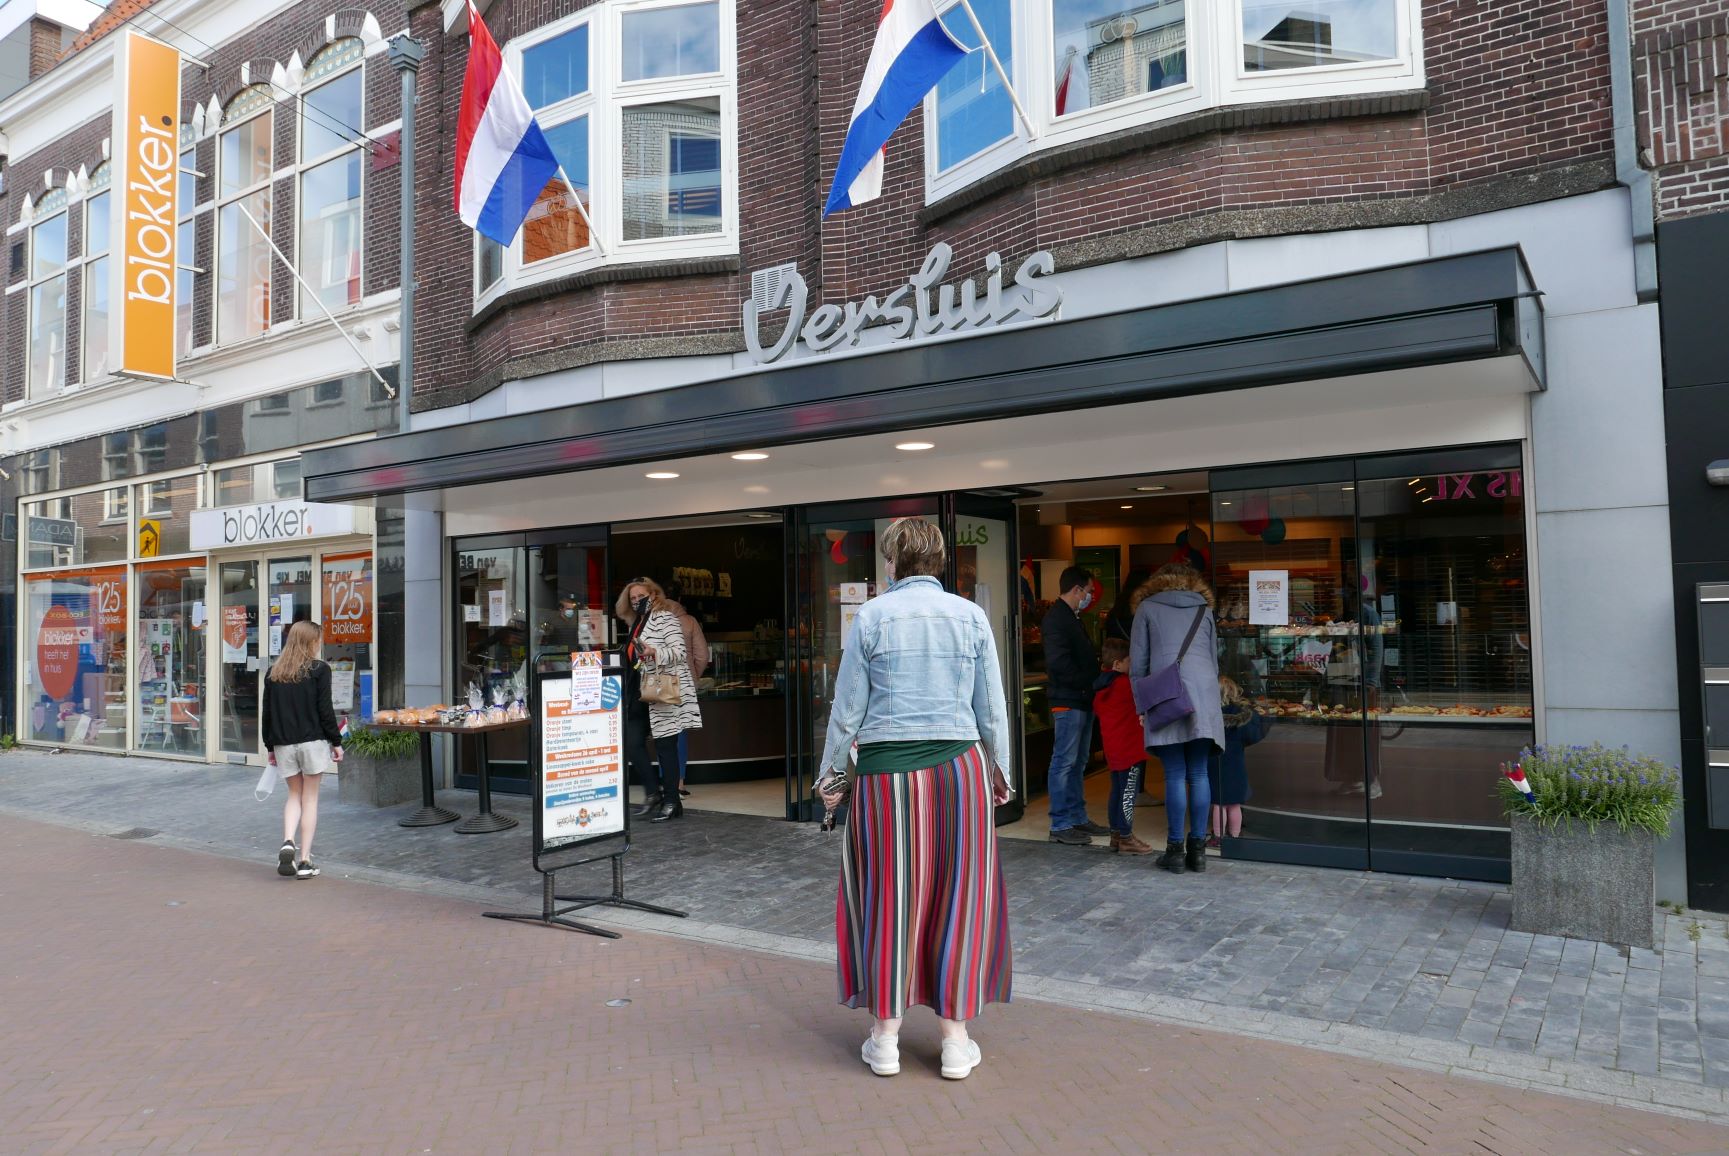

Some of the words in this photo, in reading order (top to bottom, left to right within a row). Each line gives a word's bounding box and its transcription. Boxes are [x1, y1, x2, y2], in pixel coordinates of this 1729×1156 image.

[743, 241, 1064, 363] Versluis
[97, 581, 121, 613] 125
[329, 581, 364, 620] 125
